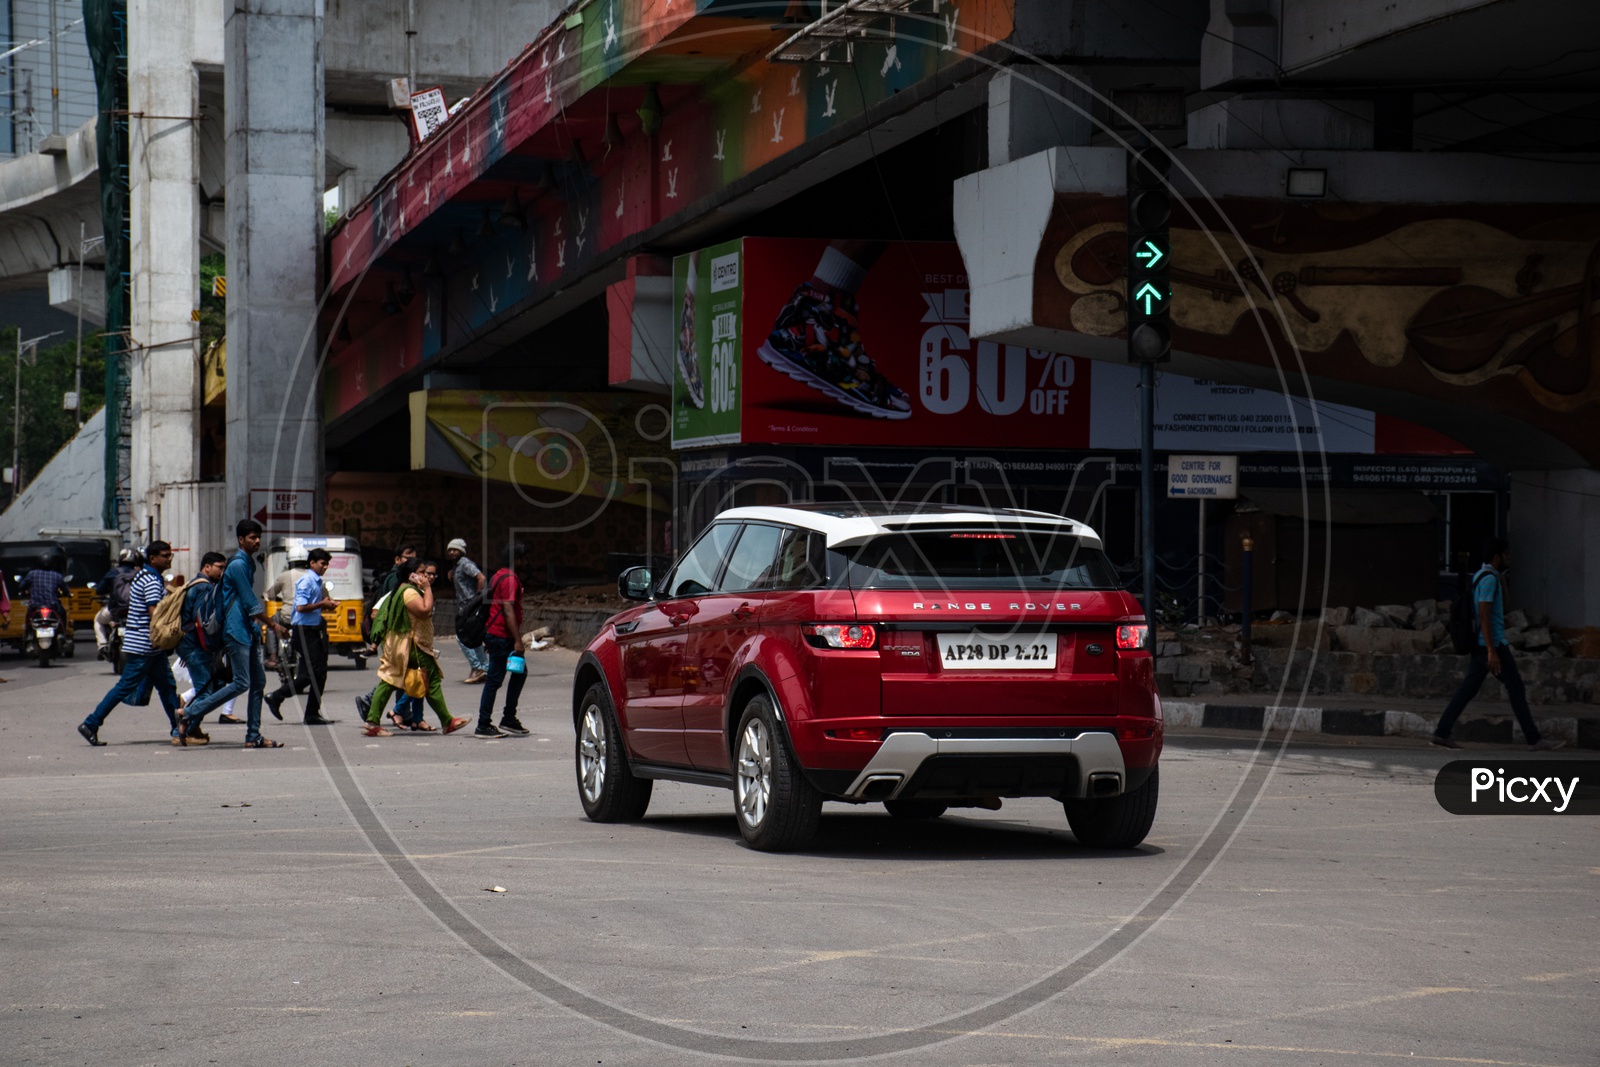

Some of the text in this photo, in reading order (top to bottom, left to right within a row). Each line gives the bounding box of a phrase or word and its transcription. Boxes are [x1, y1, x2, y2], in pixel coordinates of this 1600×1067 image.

[925, 274, 953, 284] BEST
[1029, 389, 1069, 416] OFF
[1173, 414, 1206, 422] CONNECT
[1240, 415, 1254, 423] 040
[1256, 415, 1273, 423] 2300
[1275, 415, 1291, 423] 0115
[1003, 462, 1044, 470] CYBERABAD
[1181, 461, 1221, 470] CENTRE FOR
[1353, 465, 1396, 473] INSPECTOR
[1420, 466, 1462, 474] MADHAPUR
[1171, 474, 1232, 484] GOOD GOVERNANCE
[1353, 474, 1407, 482] 9490617182
[1414, 475, 1431, 483] 040
[275, 494, 298, 502] KEEP
[275, 503, 298, 511] LEFT
[913, 603, 1082, 611] RANGE ROVER
[988, 644, 1010, 660] DP
